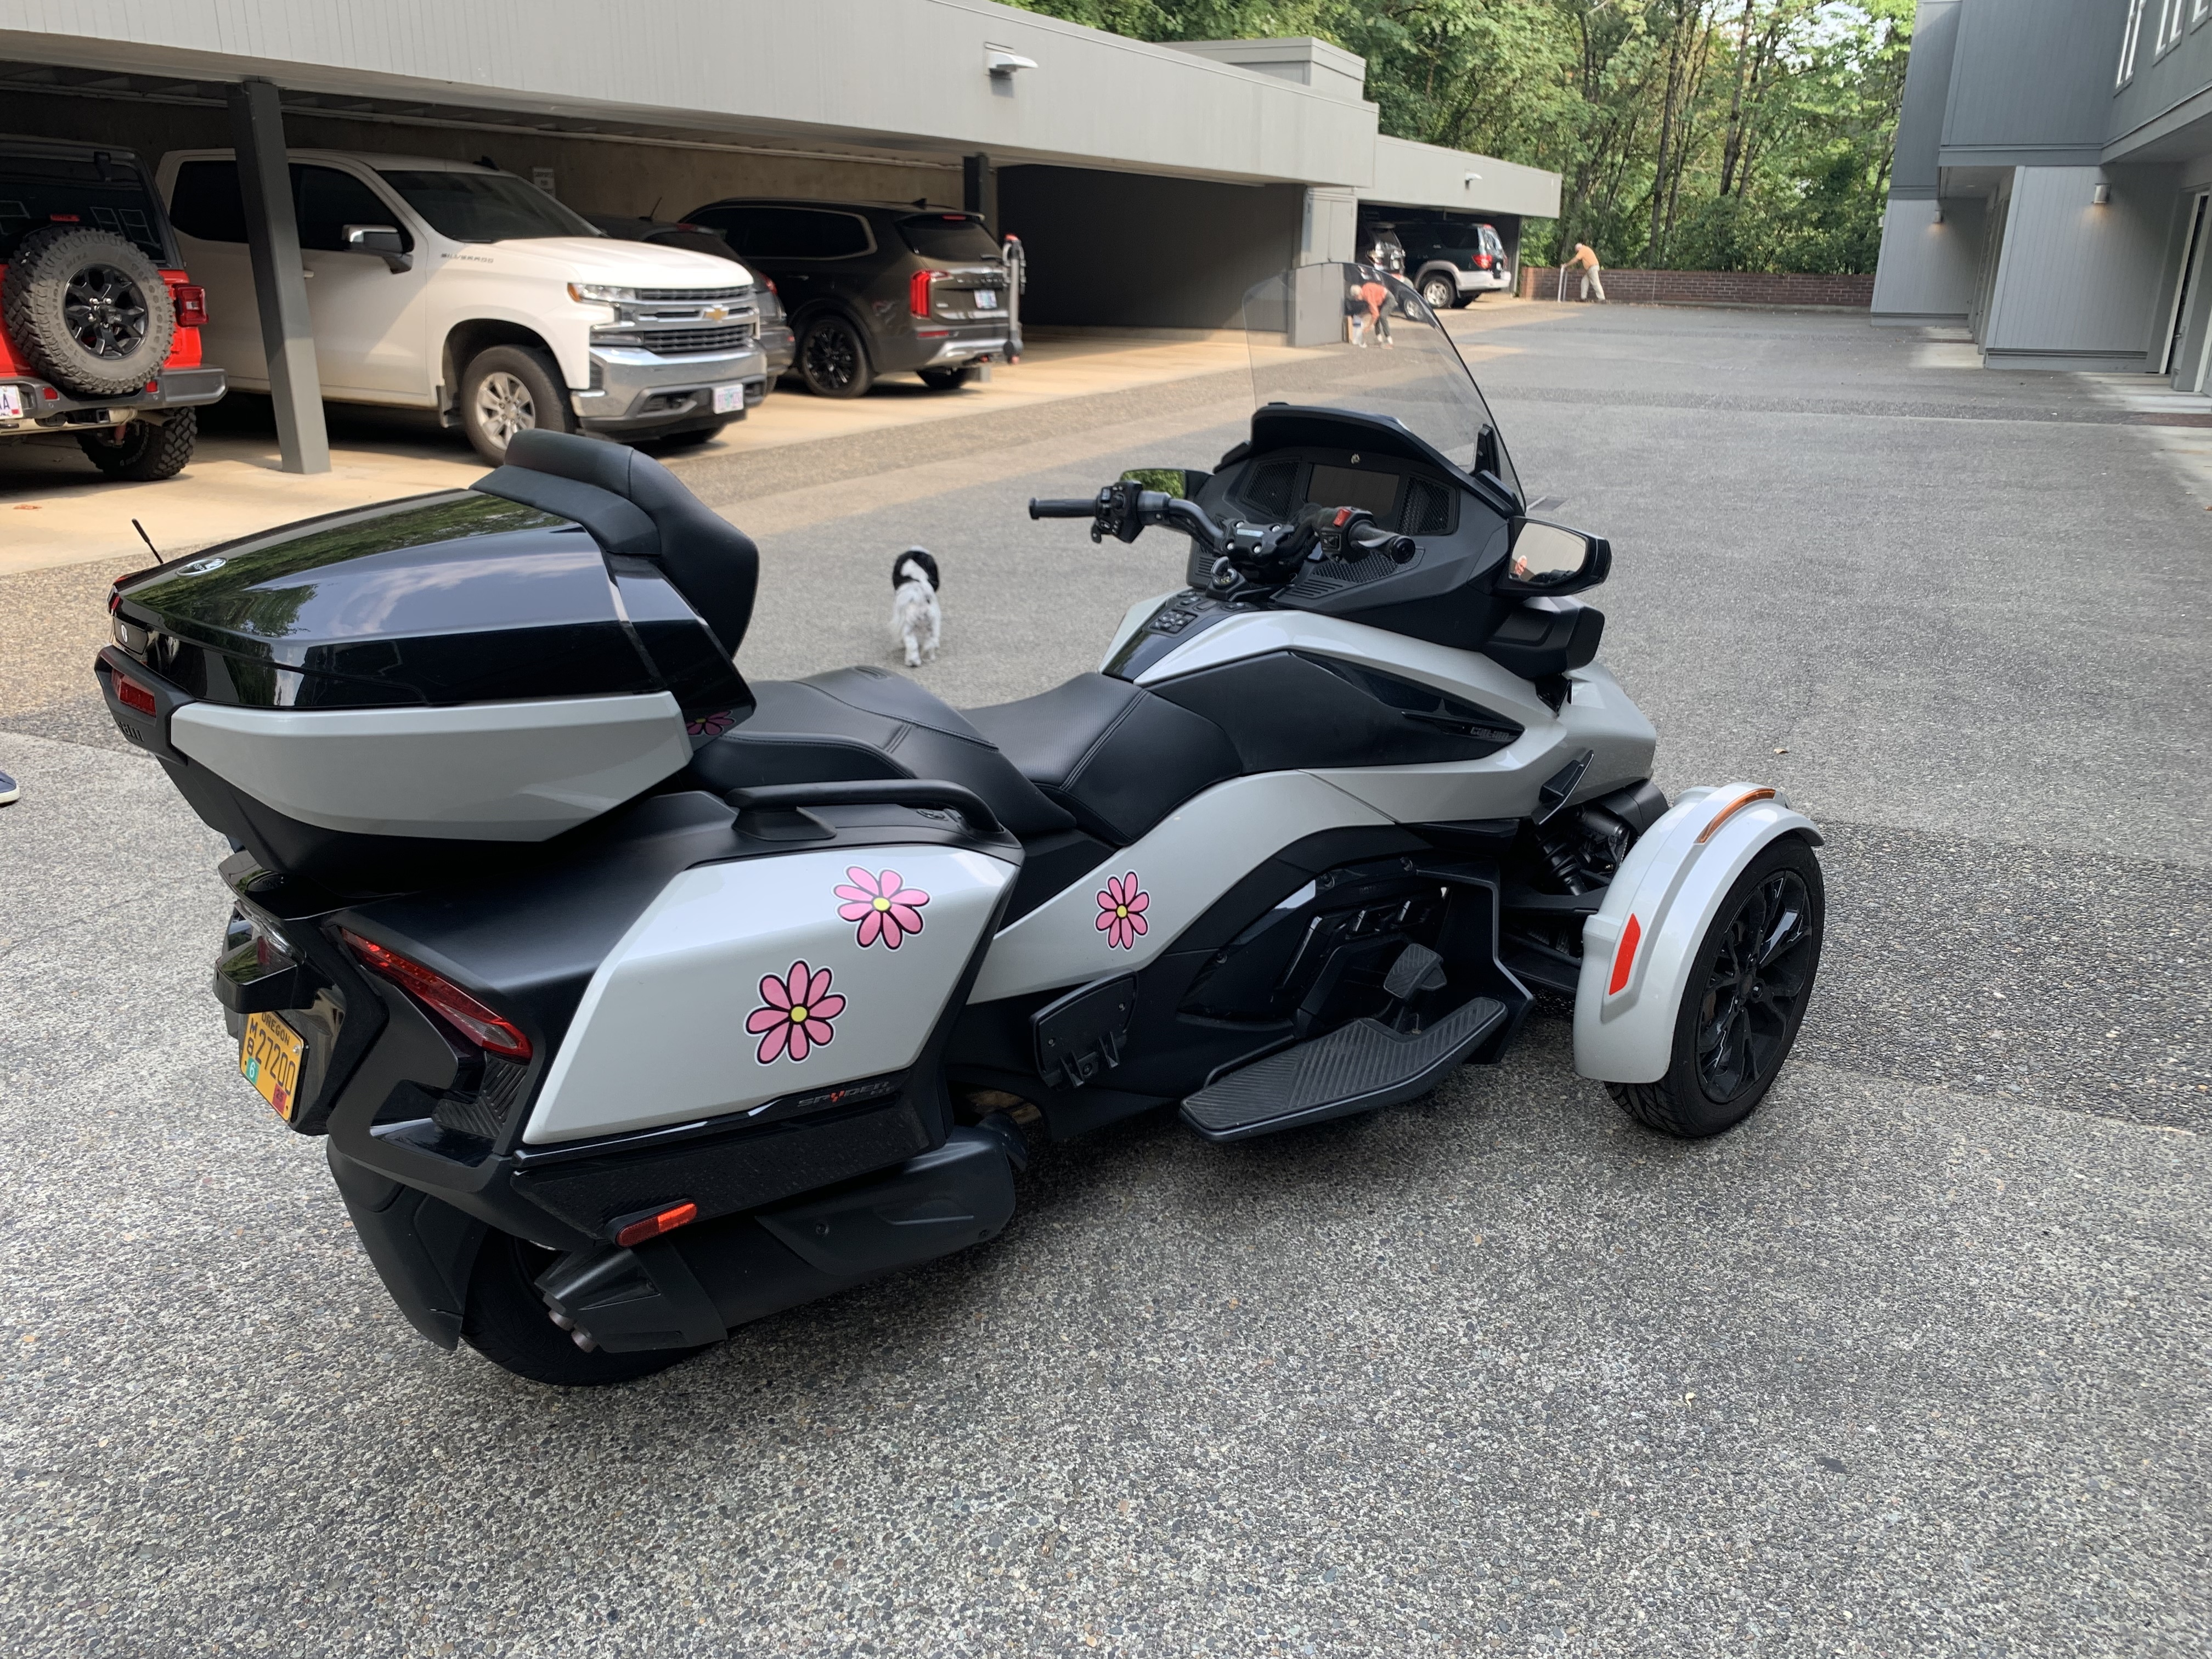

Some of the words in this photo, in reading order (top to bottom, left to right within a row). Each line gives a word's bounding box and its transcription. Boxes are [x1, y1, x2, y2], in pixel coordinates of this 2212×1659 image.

[262, 1012, 290, 1046] OREGON
[249, 1062, 256, 1078] 6
[276, 1089, 284, 1102] 25
[797, 1080, 889, 1107] SPYDER
